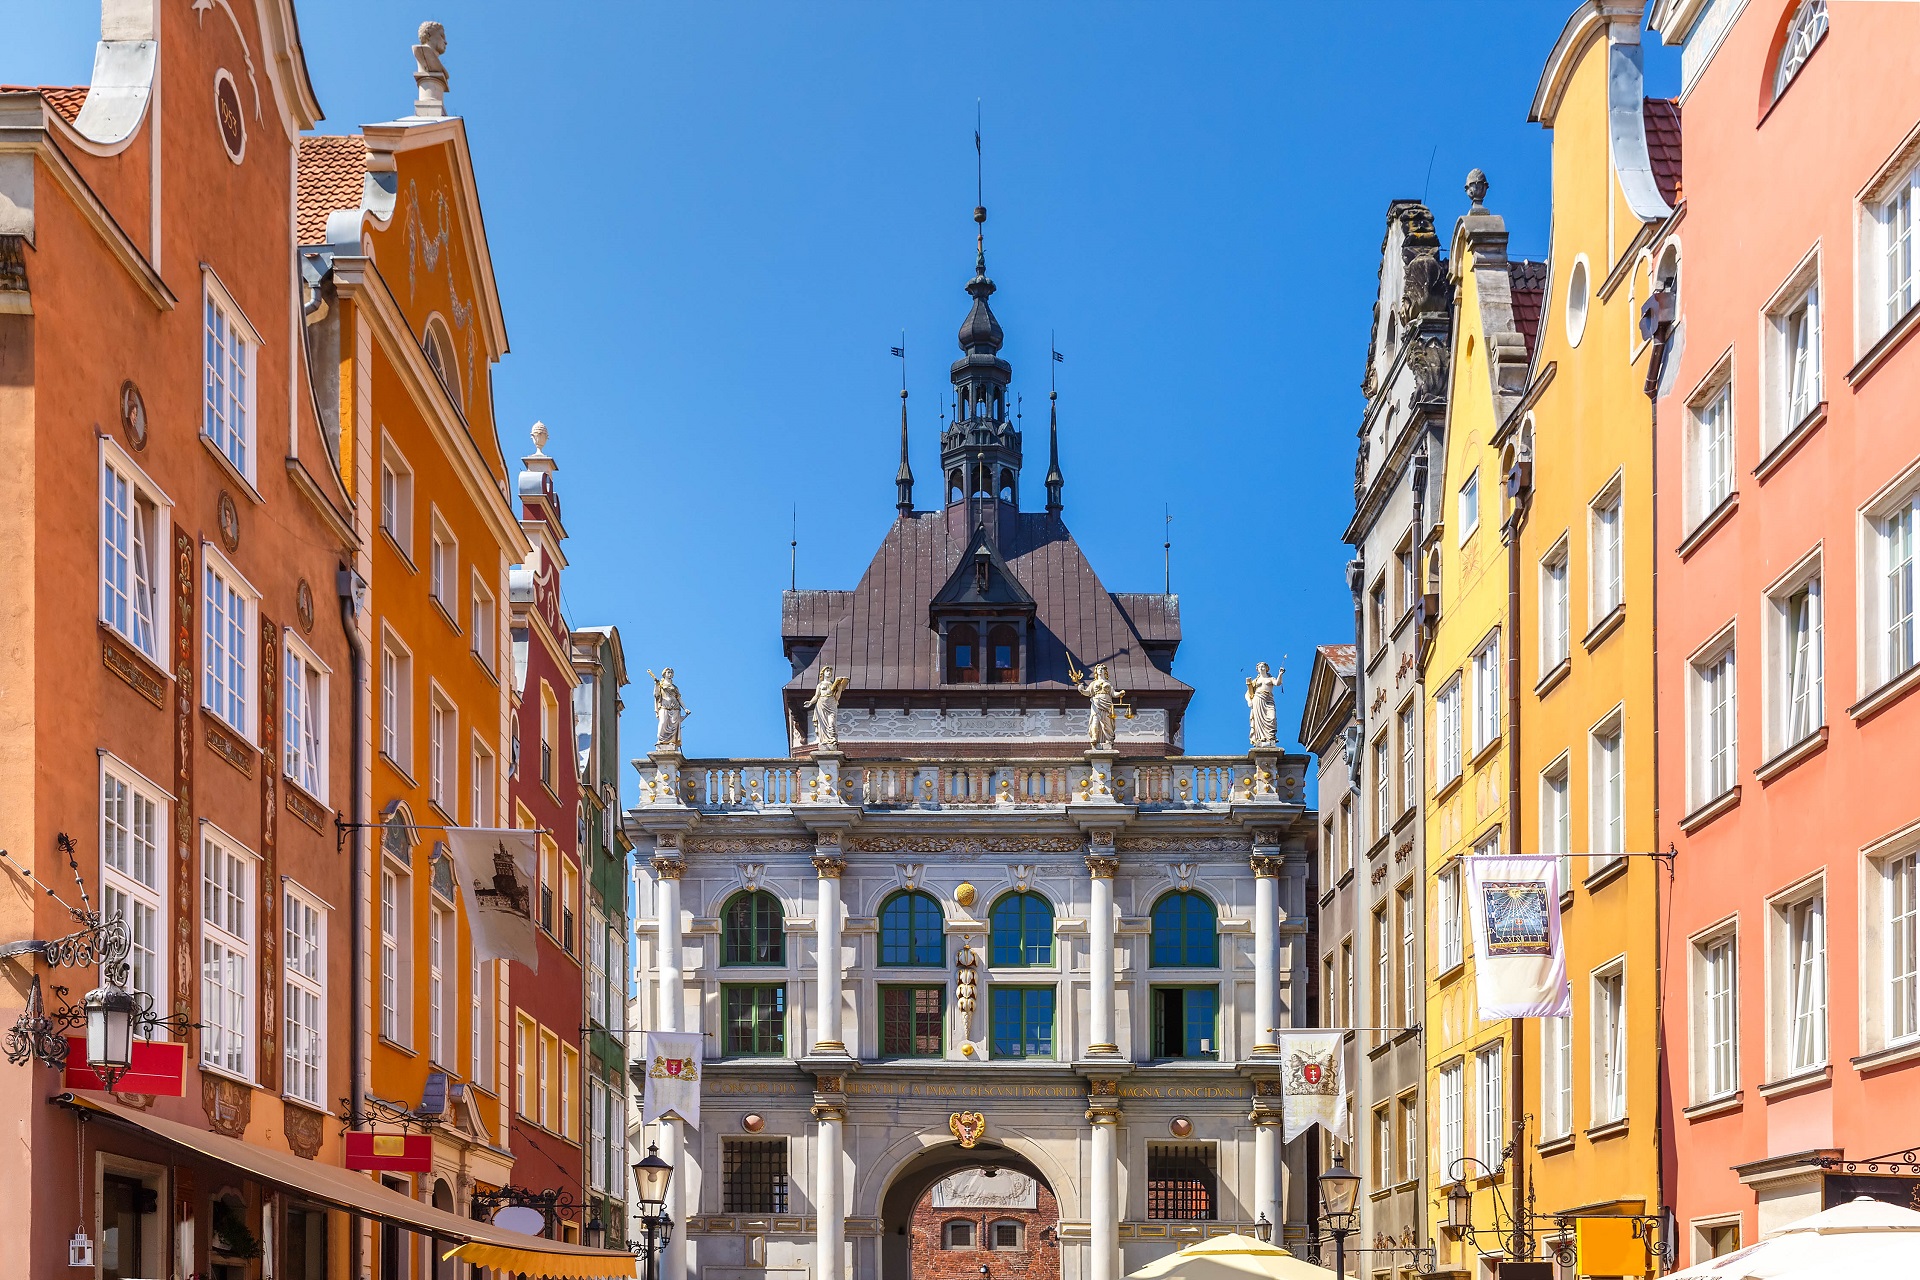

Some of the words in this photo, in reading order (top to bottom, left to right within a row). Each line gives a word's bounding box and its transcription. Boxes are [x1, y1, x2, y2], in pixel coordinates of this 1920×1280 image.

[220, 98, 237, 137] 1953
[964, 720, 995, 729] ANNO
[709, 1081, 797, 1094] CONCORDIA
[1167, 1087, 1246, 1098] CONCIDVNT
